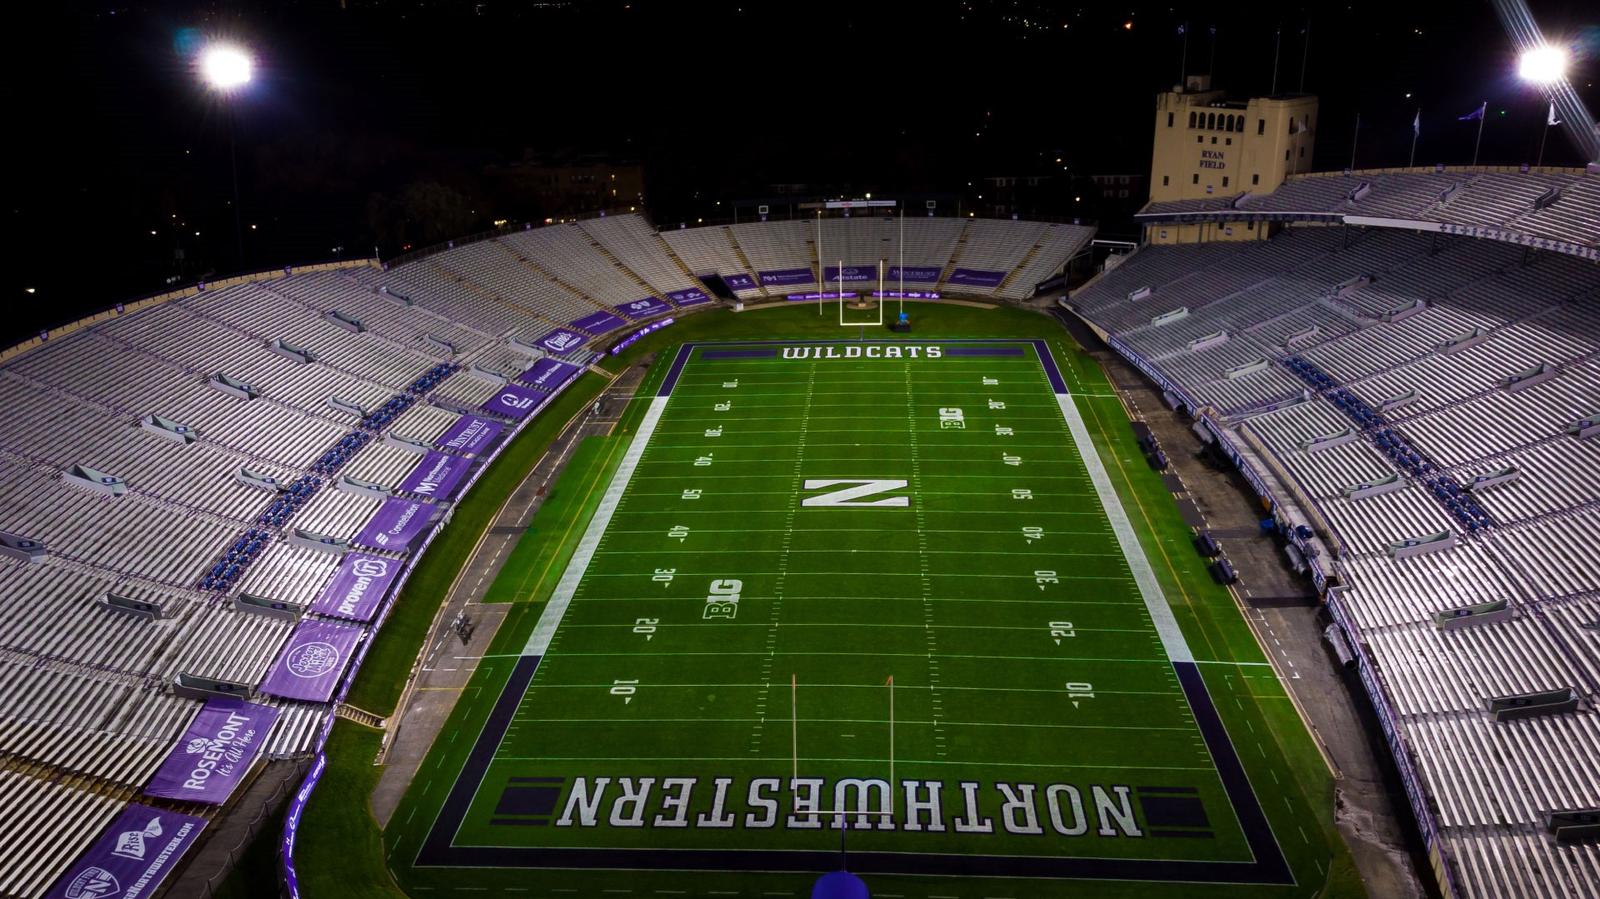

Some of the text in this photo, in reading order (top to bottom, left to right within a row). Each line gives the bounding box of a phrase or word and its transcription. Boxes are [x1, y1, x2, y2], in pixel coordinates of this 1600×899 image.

[1202, 150, 1224, 160] RYAN
[1199, 160, 1226, 170] FIELD
[782, 346, 942, 360] WILDCATS
[446, 419, 484, 447] WINTRUST
[995, 427, 1015, 436] 30
[694, 456, 712, 466] 40
[1002, 456, 1023, 467] 40
[682, 489, 702, 500] 50
[800, 479, 911, 508] N
[1011, 489, 1033, 500] 50
[388, 503, 420, 535] Constellation
[668, 525, 689, 538] 40
[1022, 526, 1045, 539] 40
[652, 568, 676, 582] 30
[1034, 570, 1059, 584] 30
[633, 618, 659, 634] 20
[1049, 621, 1076, 638] 20
[610, 679, 639, 695] 10
[1065, 681, 1096, 699] 10
[183, 712, 250, 790] ROSEMONT
[215, 729, 256, 777] It's All Here
[554, 775, 1144, 839] NORTHWESTERN
[121, 832, 140, 851] Rise
